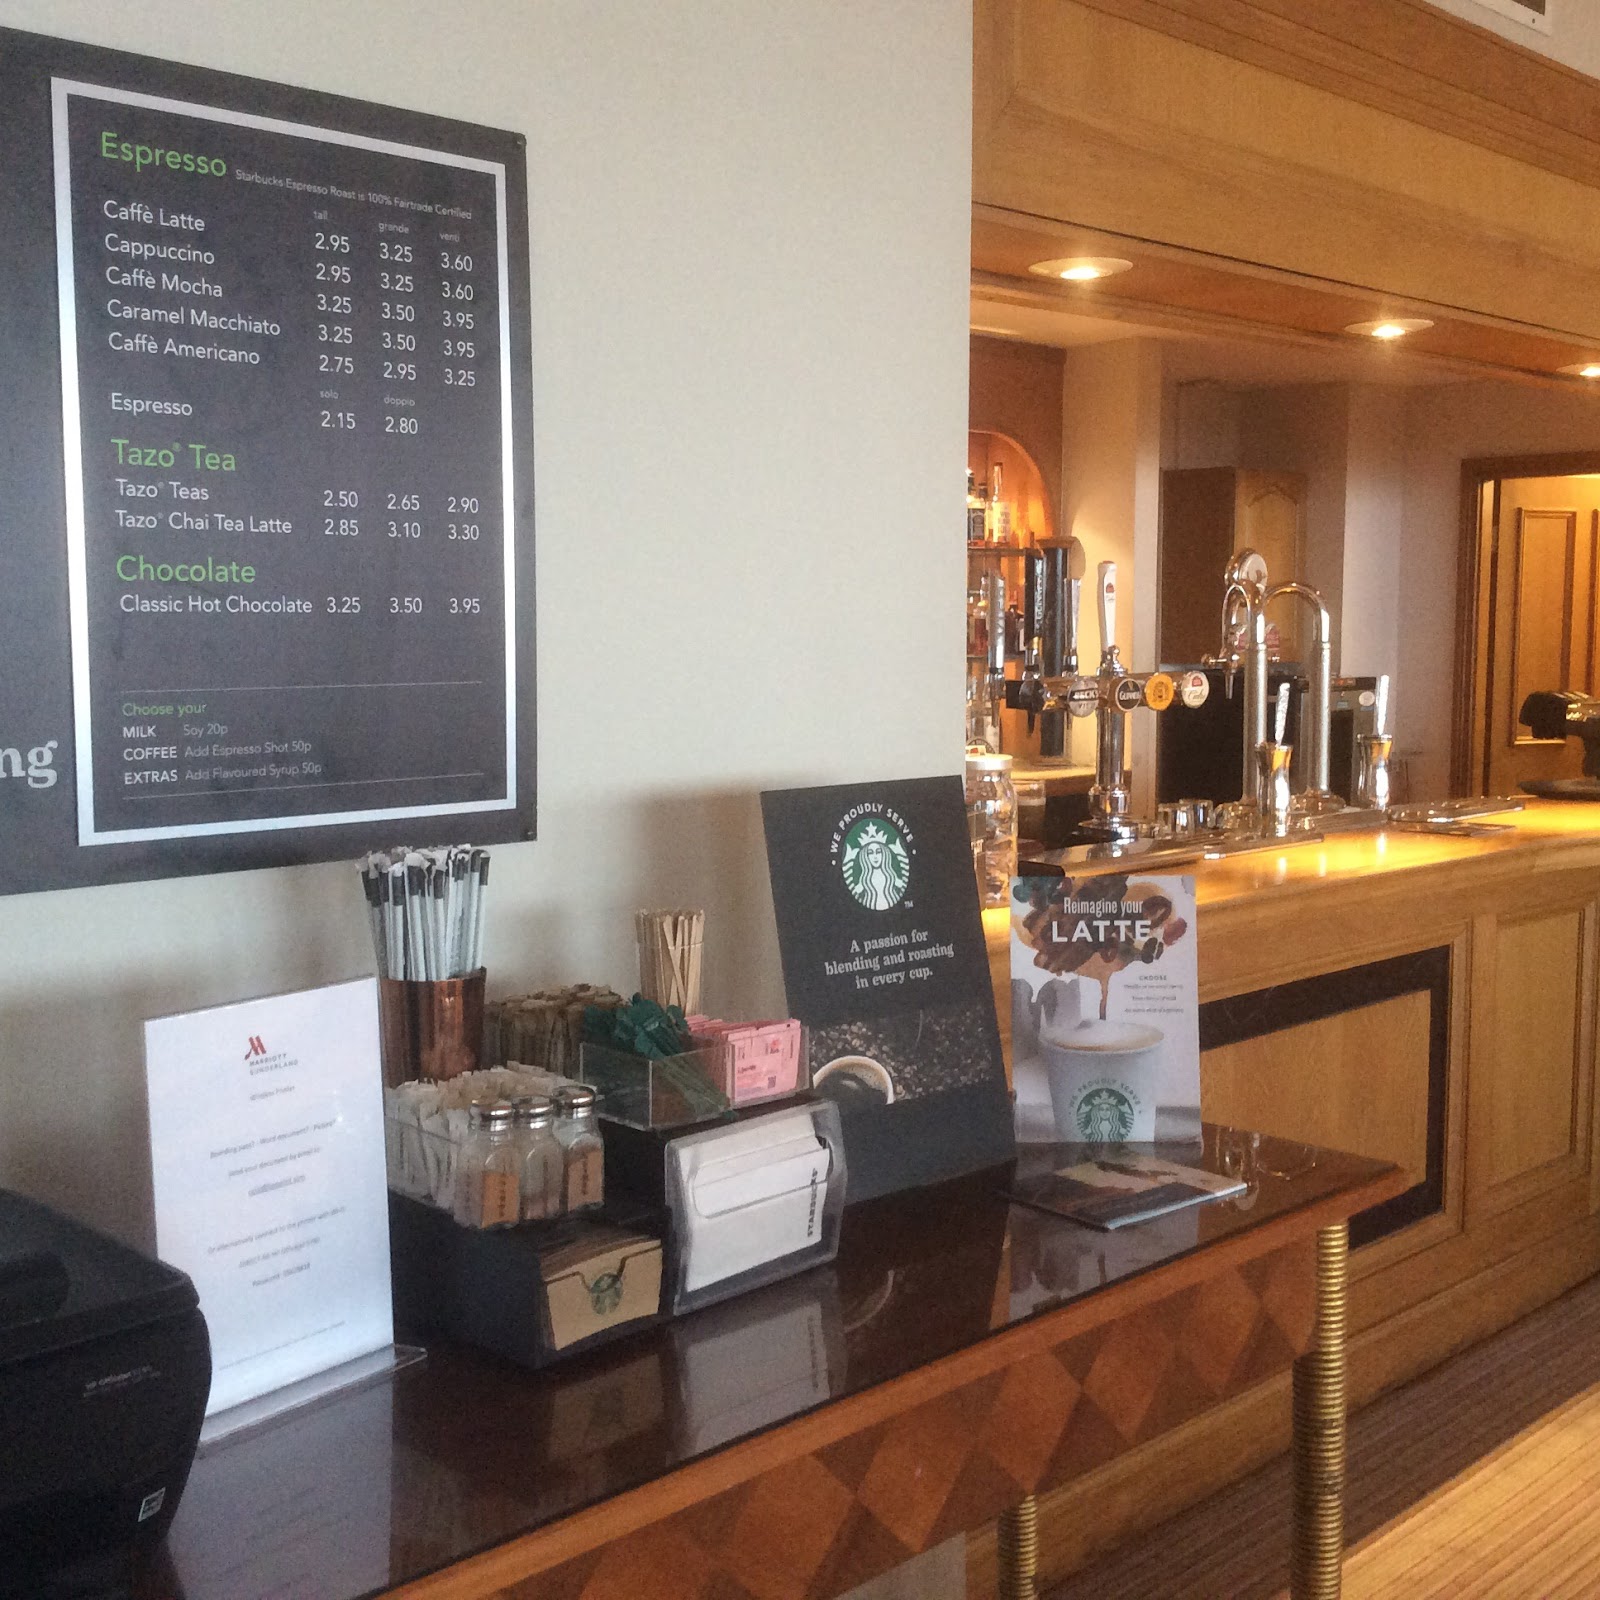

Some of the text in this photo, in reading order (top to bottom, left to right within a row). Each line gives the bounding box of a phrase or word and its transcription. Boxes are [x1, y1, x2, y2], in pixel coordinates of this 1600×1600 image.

[101, 132, 226, 177] Espresso
[236, 170, 472, 219] Starbucks Espresso Roast is 100% Fairtrade Certified
[104, 200, 205, 231] Caffè Latte
[314, 210, 460, 242] tall grande venti
[105, 234, 214, 264] Cappuccino
[315, 233, 472, 271] 2.95 3.25 3.60
[106, 266, 223, 298] Caffè Mocha
[316, 264, 473, 300] 2.95 3.25 3.60
[107, 300, 280, 335] Caramel Macchiato
[317, 295, 474, 329] 3.25 3.50 3.95
[108, 332, 260, 364] Caffè Americano
[318, 325, 475, 358] 3.25 3.50 3.95
[319, 355, 475, 387] 2.75 2.95 3.25
[111, 393, 192, 416] Espresso
[320, 390, 338, 400] solo
[321, 411, 418, 435] 2.15 2.80
[189, 444, 236, 471] Tea
[169, 482, 209, 500] Teas
[324, 491, 478, 514] 2.50 2.65 2.90
[169, 512, 209, 530] Chai
[216, 514, 243, 531] Tea
[250, 516, 292, 533] Latte
[324, 519, 479, 540] 2.85 3.10 3.30
[116, 555, 256, 583] Chocolate
[120, 595, 312, 613] Classic Hot Chocolate
[326, 597, 480, 614] 3.25 3.50 3.95
[123, 702, 206, 719] Choose your
[123, 723, 228, 738] MILK Soy 20p
[123, 741, 311, 761] COFFEE Add Espresso Shot 50p
[124, 762, 322, 784] EXTRAS Add Flavoured Syrup 50p
[830, 804, 913, 853] WE PROUDLY SERVE
[1064, 897, 1143, 917] Reimagine your
[850, 929, 928, 954] A passion for
[1052, 920, 1152, 942] LATTE
[825, 943, 954, 976] blending and roasting
[856, 966, 933, 989] in every cup.
[249, 1053, 287, 1067] MARRIOTT
